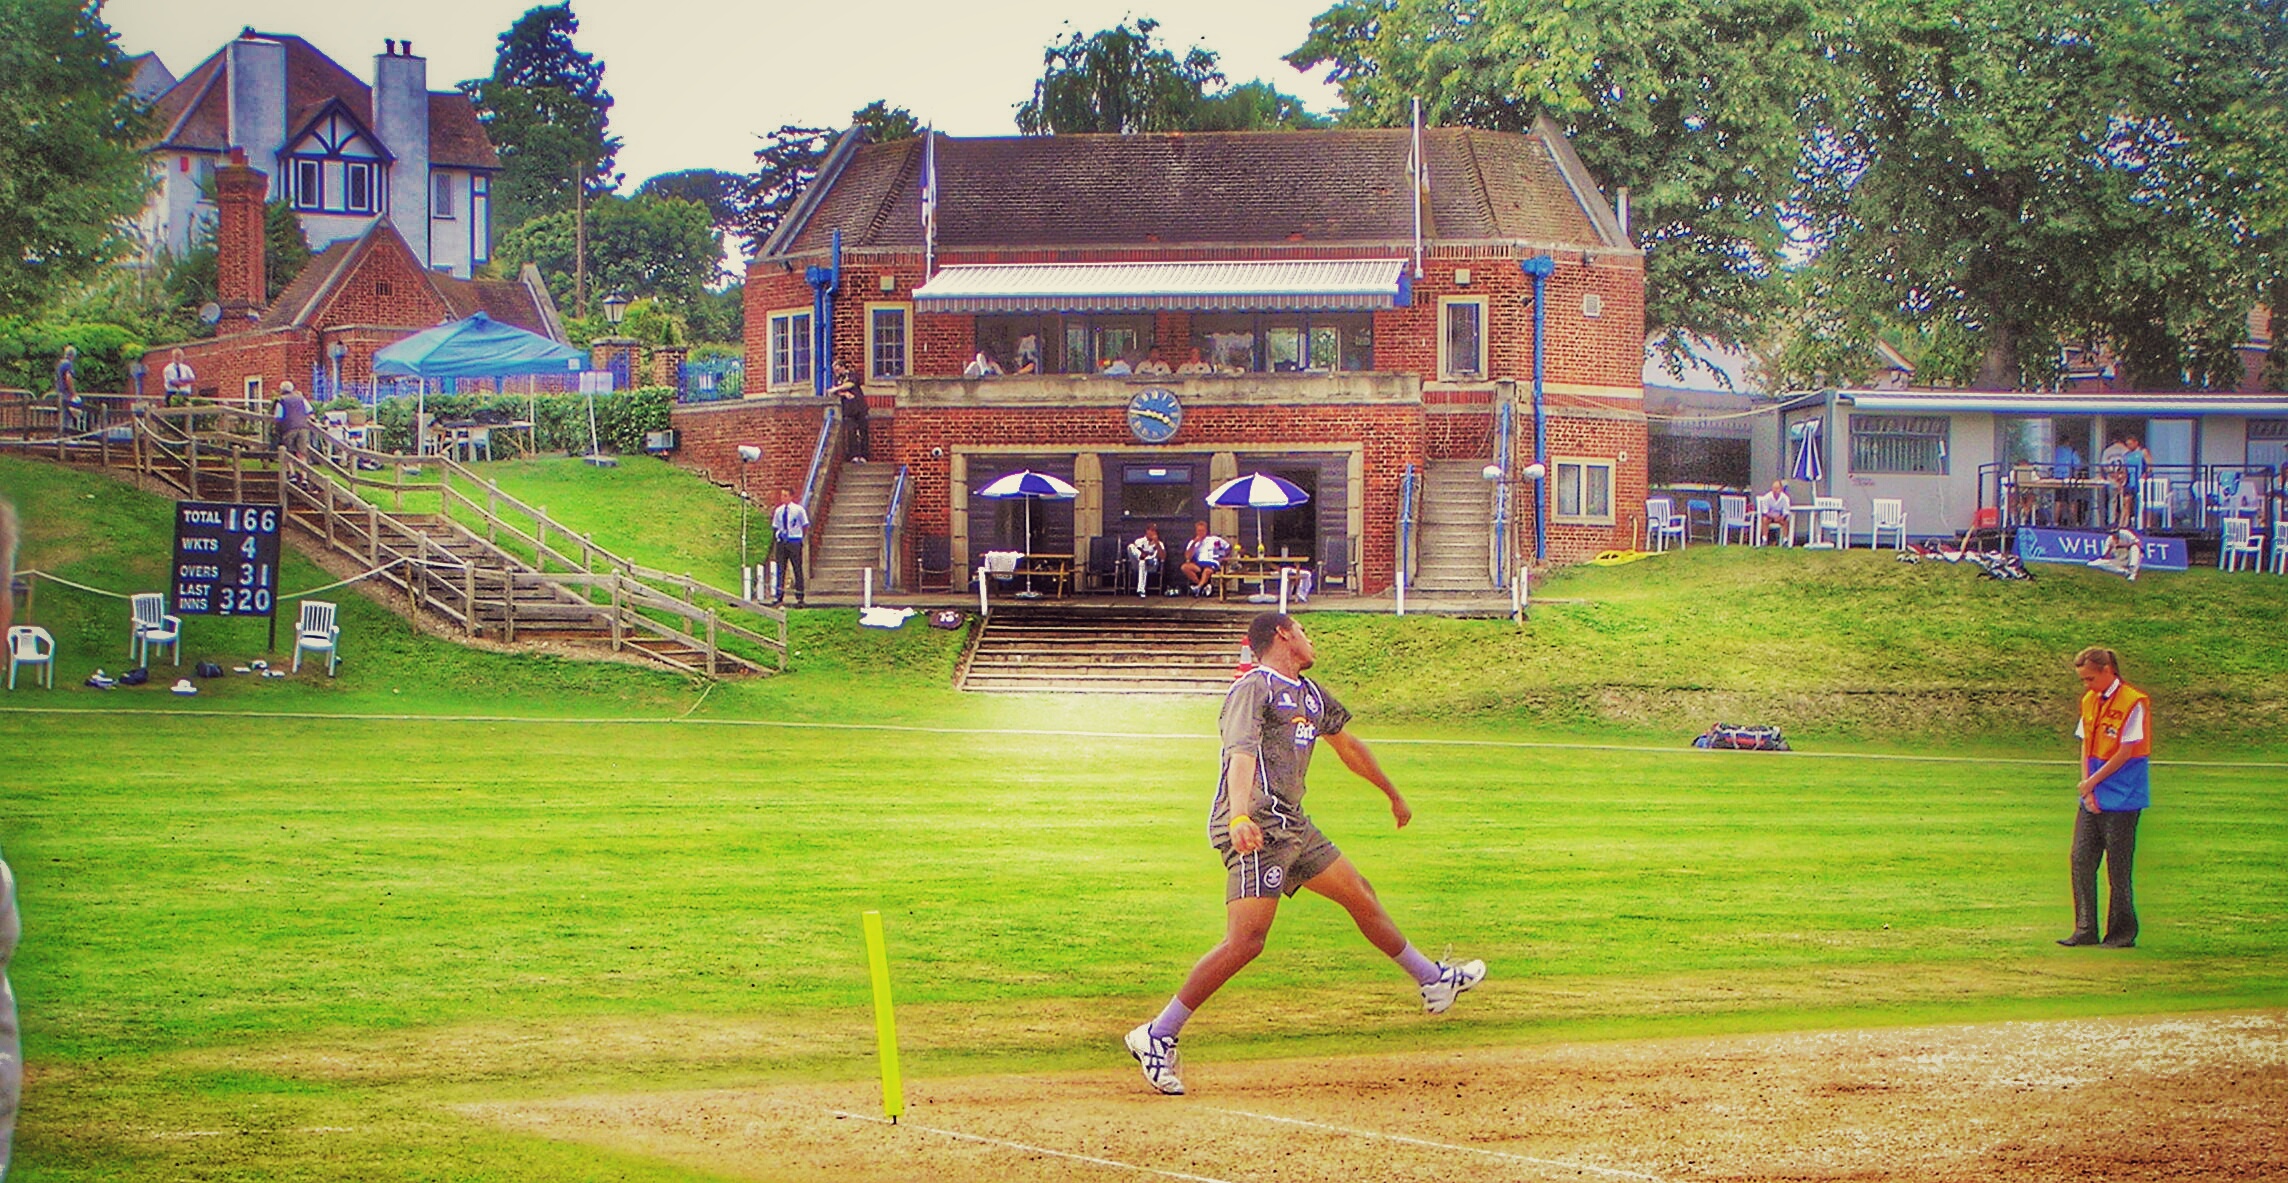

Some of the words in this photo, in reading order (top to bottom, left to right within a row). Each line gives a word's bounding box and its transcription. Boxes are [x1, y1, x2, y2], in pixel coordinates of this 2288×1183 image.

[183, 509, 222, 524] TOTAL
[228, 508, 276, 532] 166
[181, 537, 219, 551] WKTS
[240, 535, 257, 559] 4
[179, 565, 219, 579] OVERS
[239, 563, 269, 587] 31
[179, 583, 211, 596] LAST
[179, 598, 209, 610] INNS
[220, 587, 271, 612] 320
